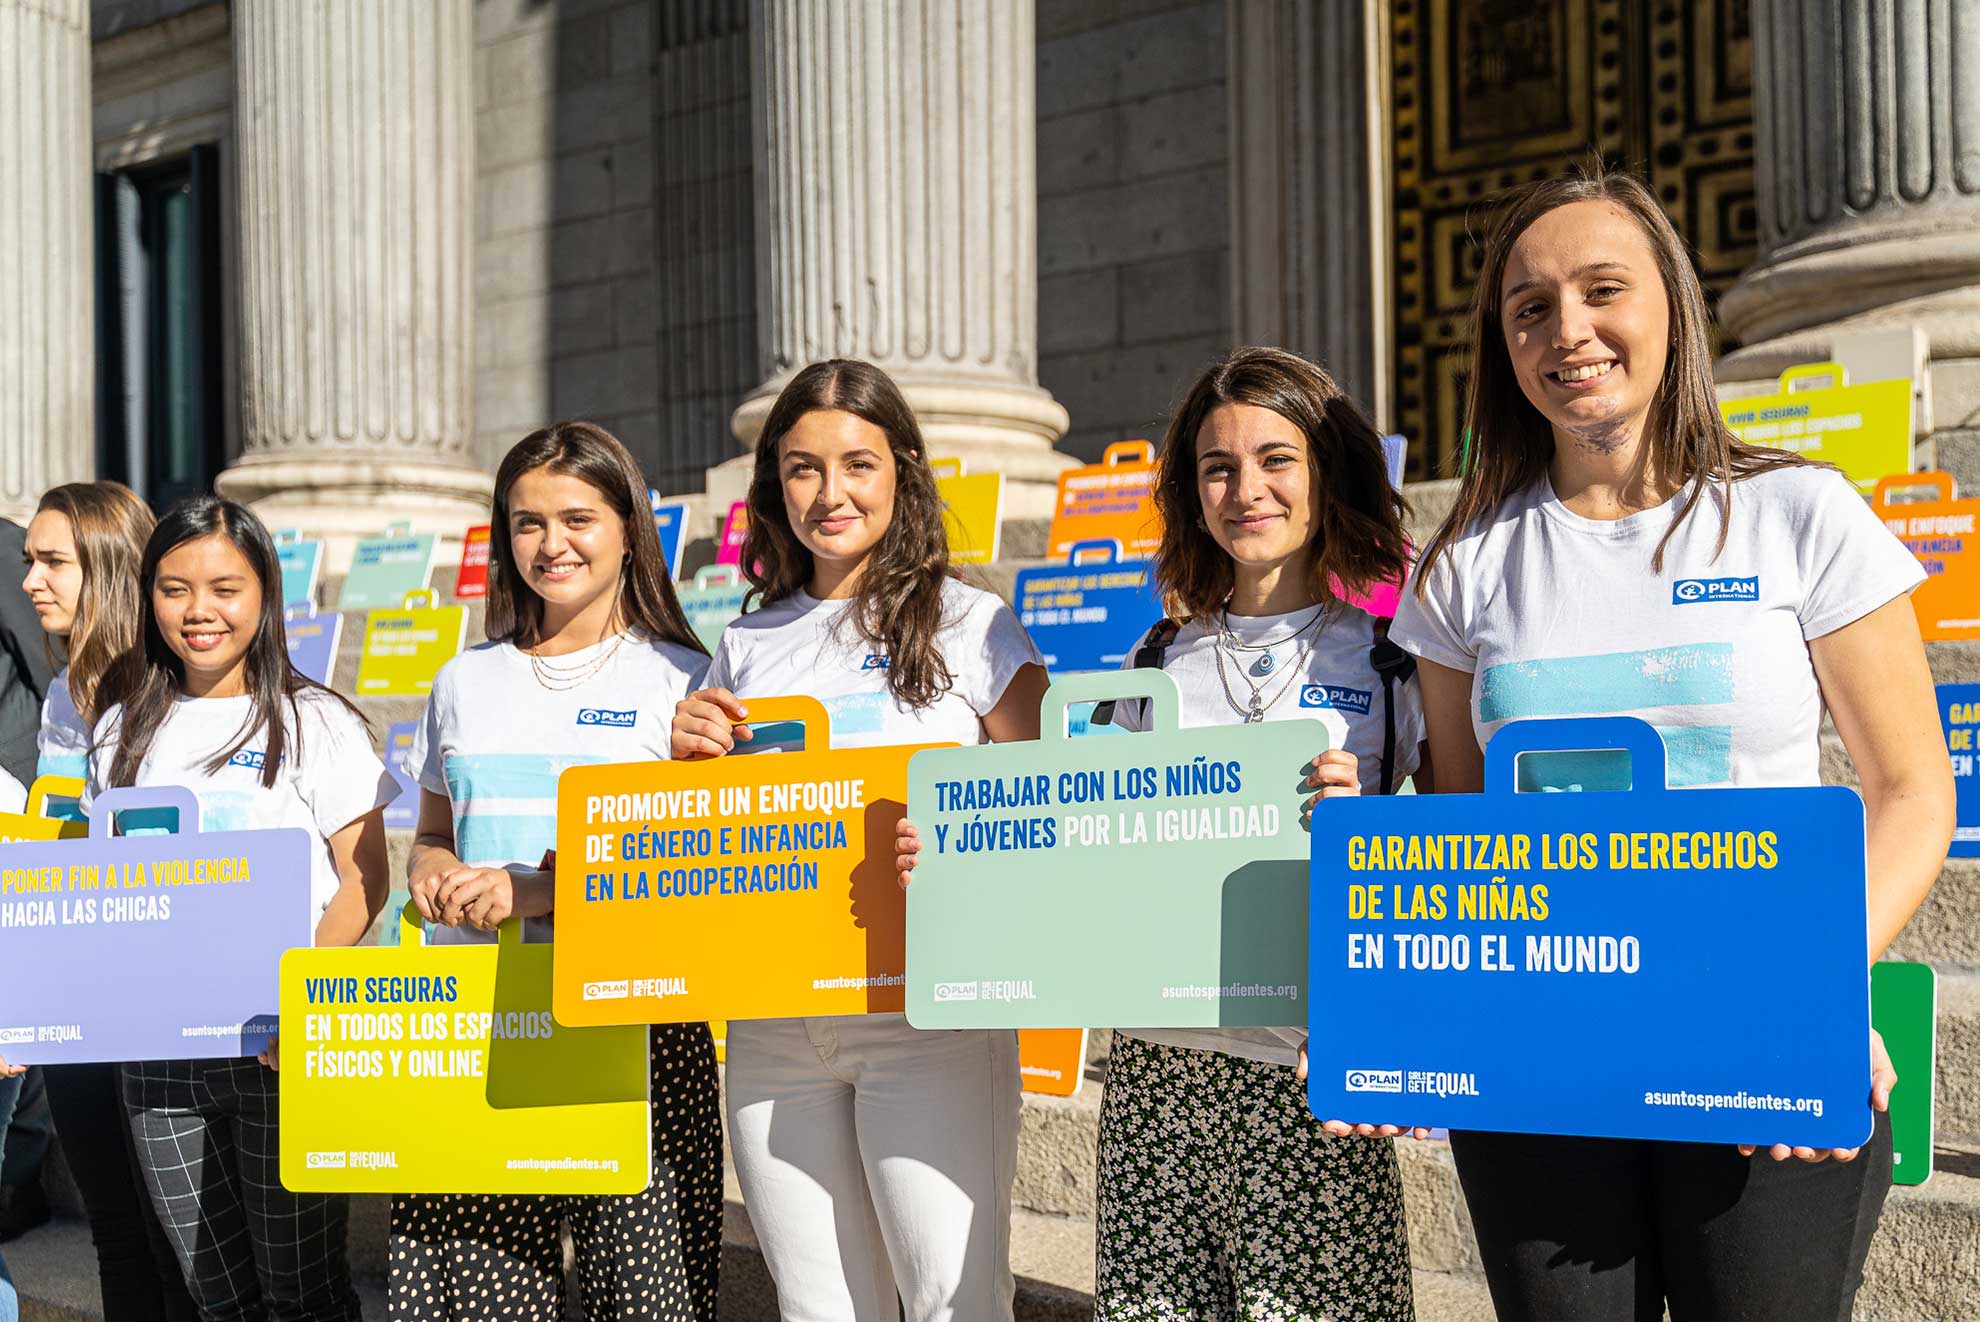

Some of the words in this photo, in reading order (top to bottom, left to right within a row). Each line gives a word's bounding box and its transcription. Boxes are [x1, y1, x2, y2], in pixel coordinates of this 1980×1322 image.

[1709, 582, 1755, 593] PLAN
[1330, 690, 1369, 706] PLAN
[602, 712, 634, 722] PLAN
[1949, 729, 1973, 750] DE
[935, 774, 1050, 812] TRABAJAR
[1058, 771, 1104, 804] CON
[1113, 766, 1157, 800] LOS
[1165, 755, 1241, 797] NIÑOS
[586, 788, 711, 825] PROMOVER
[719, 787, 750, 816] UN
[759, 779, 865, 816] ENFOQUE
[585, 834, 614, 863] DE
[621, 825, 711, 861] GÉNERO
[719, 827, 732, 855] E
[740, 820, 847, 854] INFANCIA
[935, 823, 949, 854] Y
[955, 814, 1056, 853] JÓVENES
[1064, 814, 1110, 848] POR
[1118, 812, 1147, 845] LA
[1156, 804, 1280, 842] IGUALDAD
[1347, 834, 1531, 872] GARANTIZAR
[1541, 832, 1598, 870] LOS
[1609, 830, 1779, 870] DERECHOS
[2, 867, 63, 894] PONER
[69, 865, 99, 891] FIN
[105, 864, 117, 888] A
[124, 862, 147, 888] LA
[152, 856, 250, 887] VIOLENCIA
[585, 873, 614, 902] EN
[622, 871, 650, 900] LA
[657, 855, 819, 898] COOPERACIÓN
[1, 900, 56, 928] HACIA
[62, 898, 96, 925] LAS
[102, 894, 171, 923] CHICAS
[1347, 884, 1384, 920] DE
[1394, 884, 1447, 920] LAS
[1457, 876, 1549, 921] NIÑAS
[1347, 933, 1384, 969] EN
[1394, 934, 1470, 971] TODO
[1480, 936, 1515, 972] EL
[1525, 935, 1640, 974] MUNDO
[305, 977, 358, 1004] VIVIR
[365, 976, 458, 1003] SEGURAS
[602, 984, 626, 992] PLAN
[647, 977, 688, 999] EQUAL
[812, 971, 906, 991] asuntospendient
[952, 985, 976, 994] PLAN
[995, 979, 1036, 1003] EQUAL
[1162, 981, 1298, 1001] asuntospendientes.org
[50, 1024, 83, 1044] EQUAL
[182, 1022, 279, 1039] asuntospendientes.or
[306, 1014, 331, 1041] EN
[337, 1013, 404, 1041] TODOS
[409, 1013, 447, 1040] LOS
[454, 1011, 553, 1040] ESPACIOS
[306, 1047, 383, 1078] FÍSICOS
[391, 1050, 404, 1077] Y
[408, 1050, 483, 1077] ONLINE
[1369, 1074, 1399, 1084] PLAN
[1408, 1080, 1427, 1094] GET
[1426, 1071, 1480, 1098] EQUAL
[1644, 1088, 1824, 1117] asuntospendientes.org
[362, 1151, 399, 1171] EQUAL
[506, 1157, 619, 1174] asuntospendientes.org
